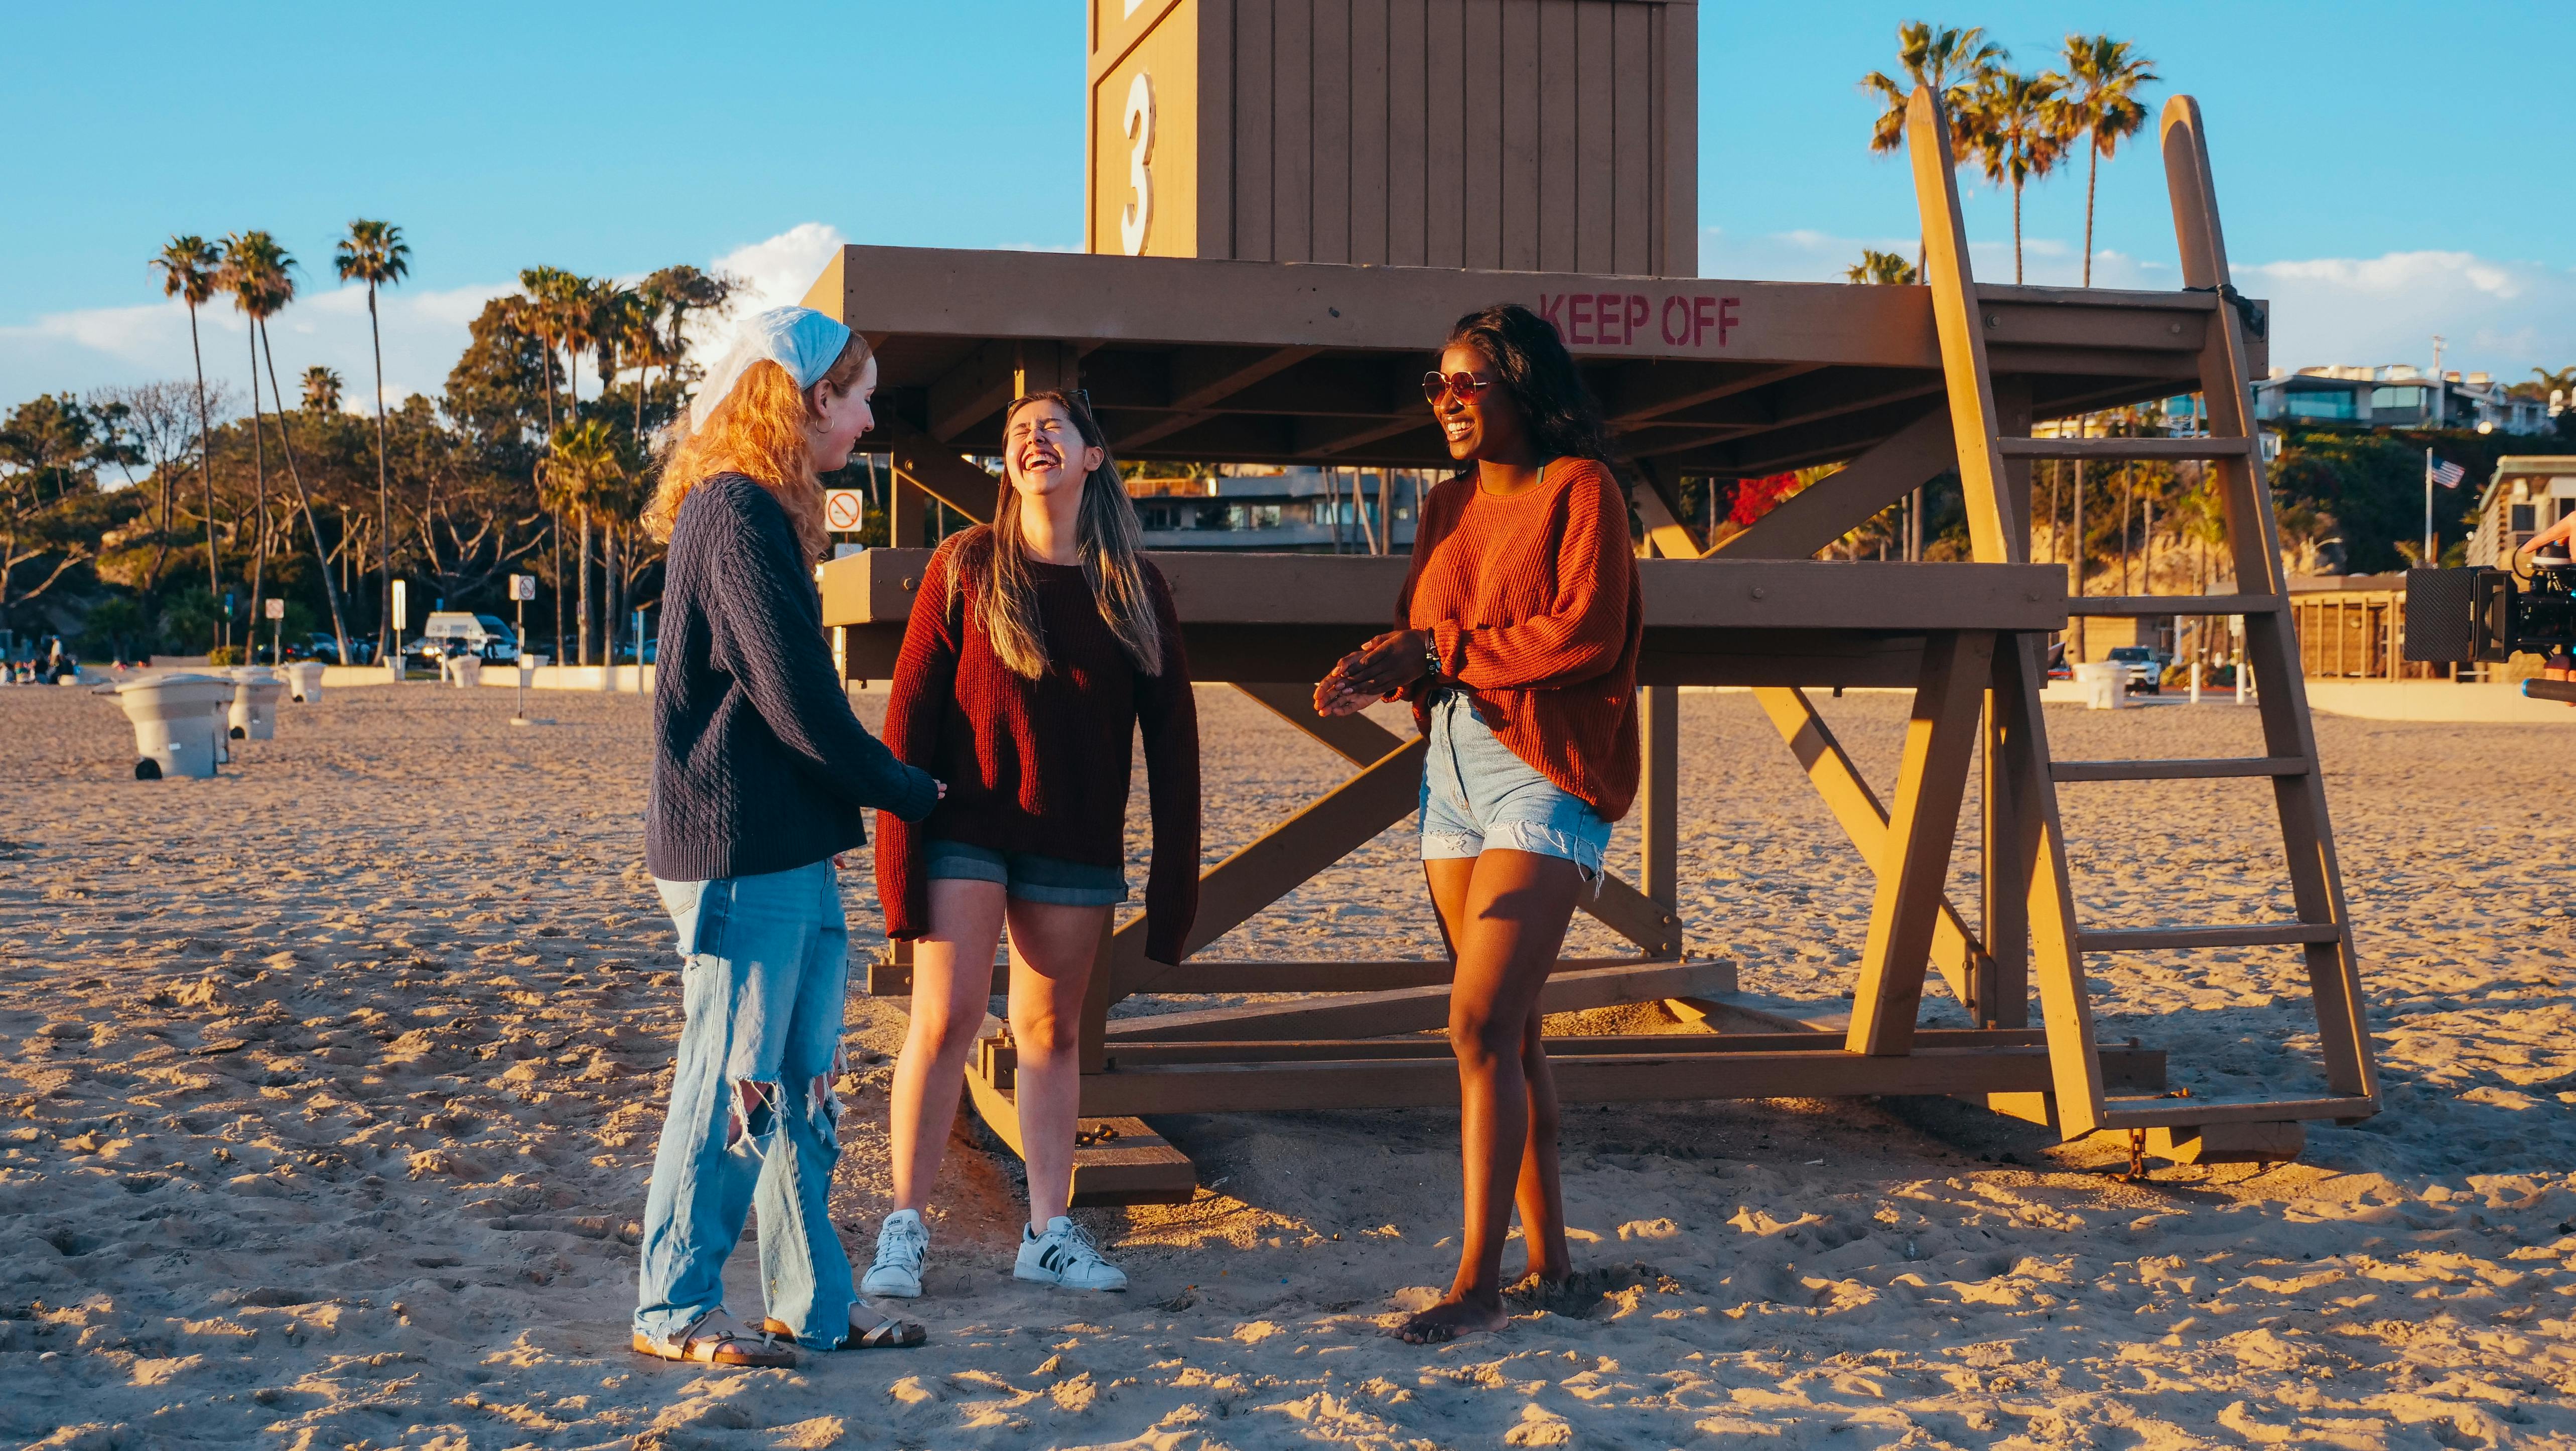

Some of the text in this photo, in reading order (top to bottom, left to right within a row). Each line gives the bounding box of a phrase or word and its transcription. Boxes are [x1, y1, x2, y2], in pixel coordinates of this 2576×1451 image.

[1121, 73, 1155, 256] 3
[1540, 294, 1740, 348] KEEP OFF
